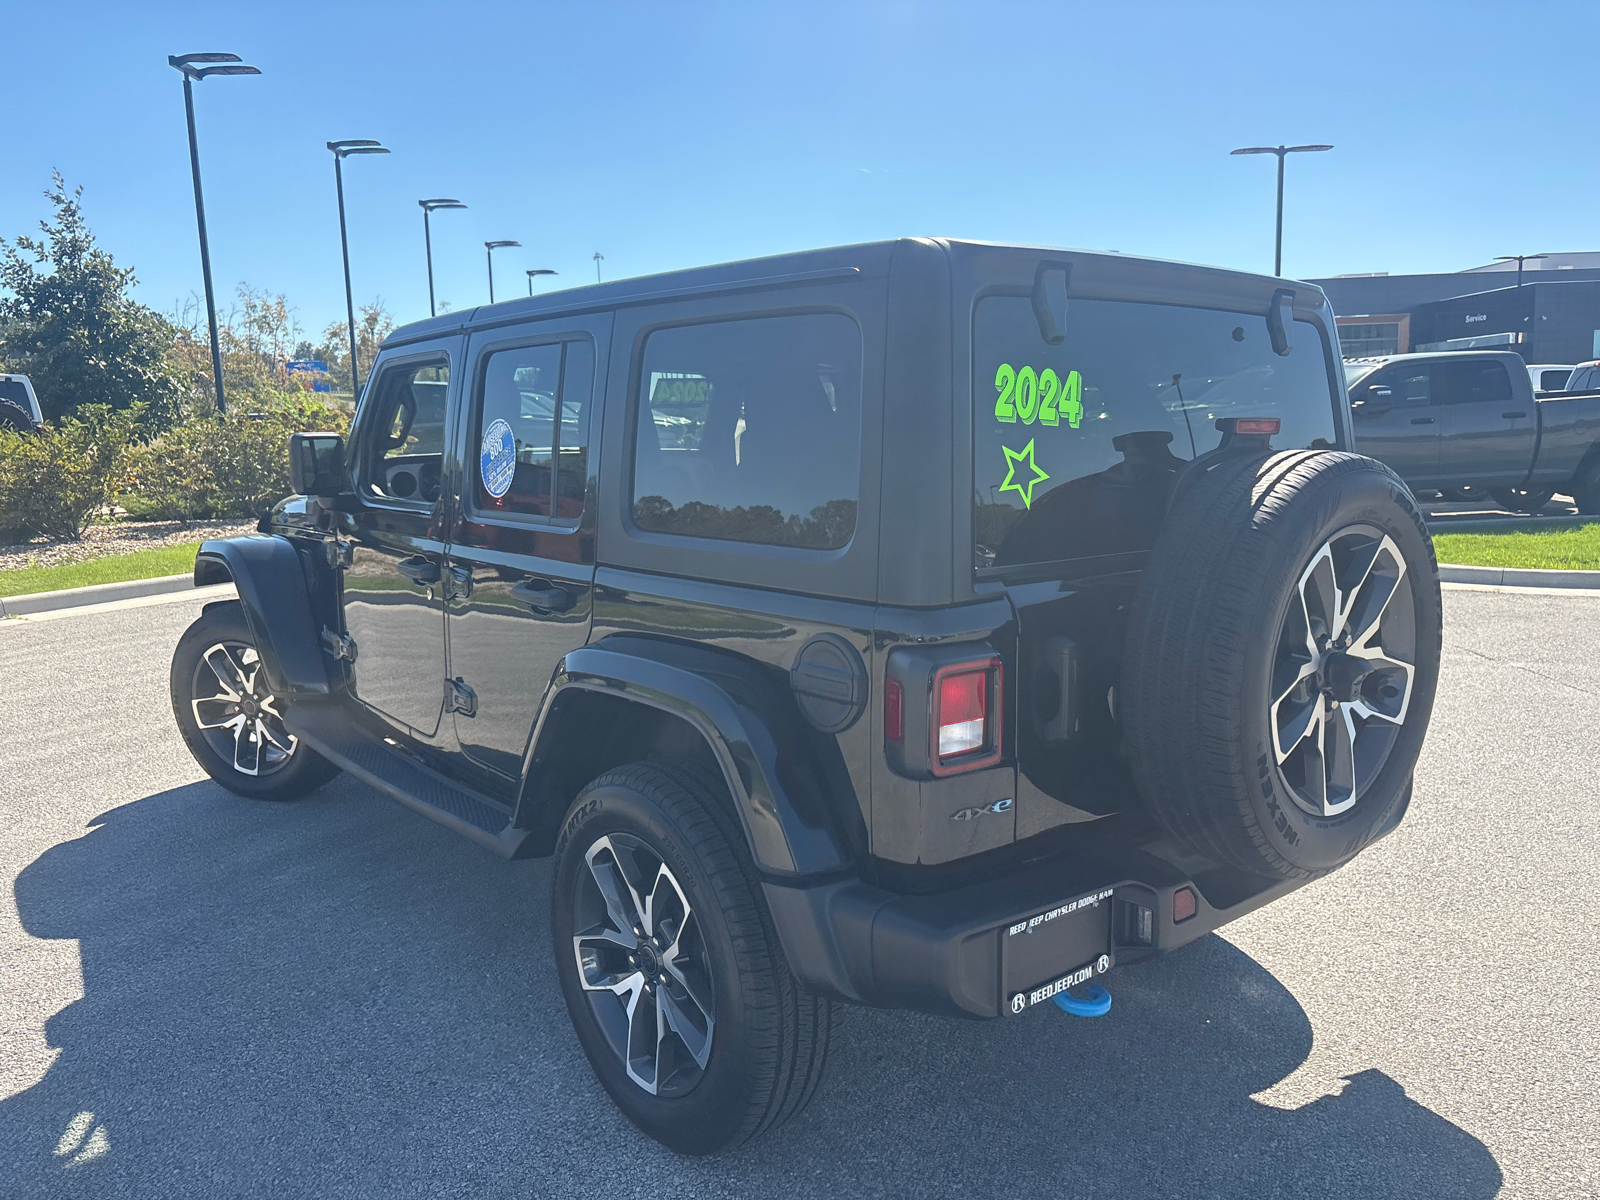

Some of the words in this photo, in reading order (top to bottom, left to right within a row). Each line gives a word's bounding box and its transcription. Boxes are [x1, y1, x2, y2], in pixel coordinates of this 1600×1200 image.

[1465, 314, 1487, 323] Service
[995, 363, 1084, 428] 2024
[490, 439, 503, 460] 800
[1256, 753, 1298, 846] NEXEN
[1009, 922, 1027, 936] REED
[1028, 914, 1044, 928] JEEP
[1044, 901, 1077, 922] CHRYSLER
[1077, 894, 1098, 909] DODGE
[1030, 965, 1092, 1006] REEDJEEP.COM
